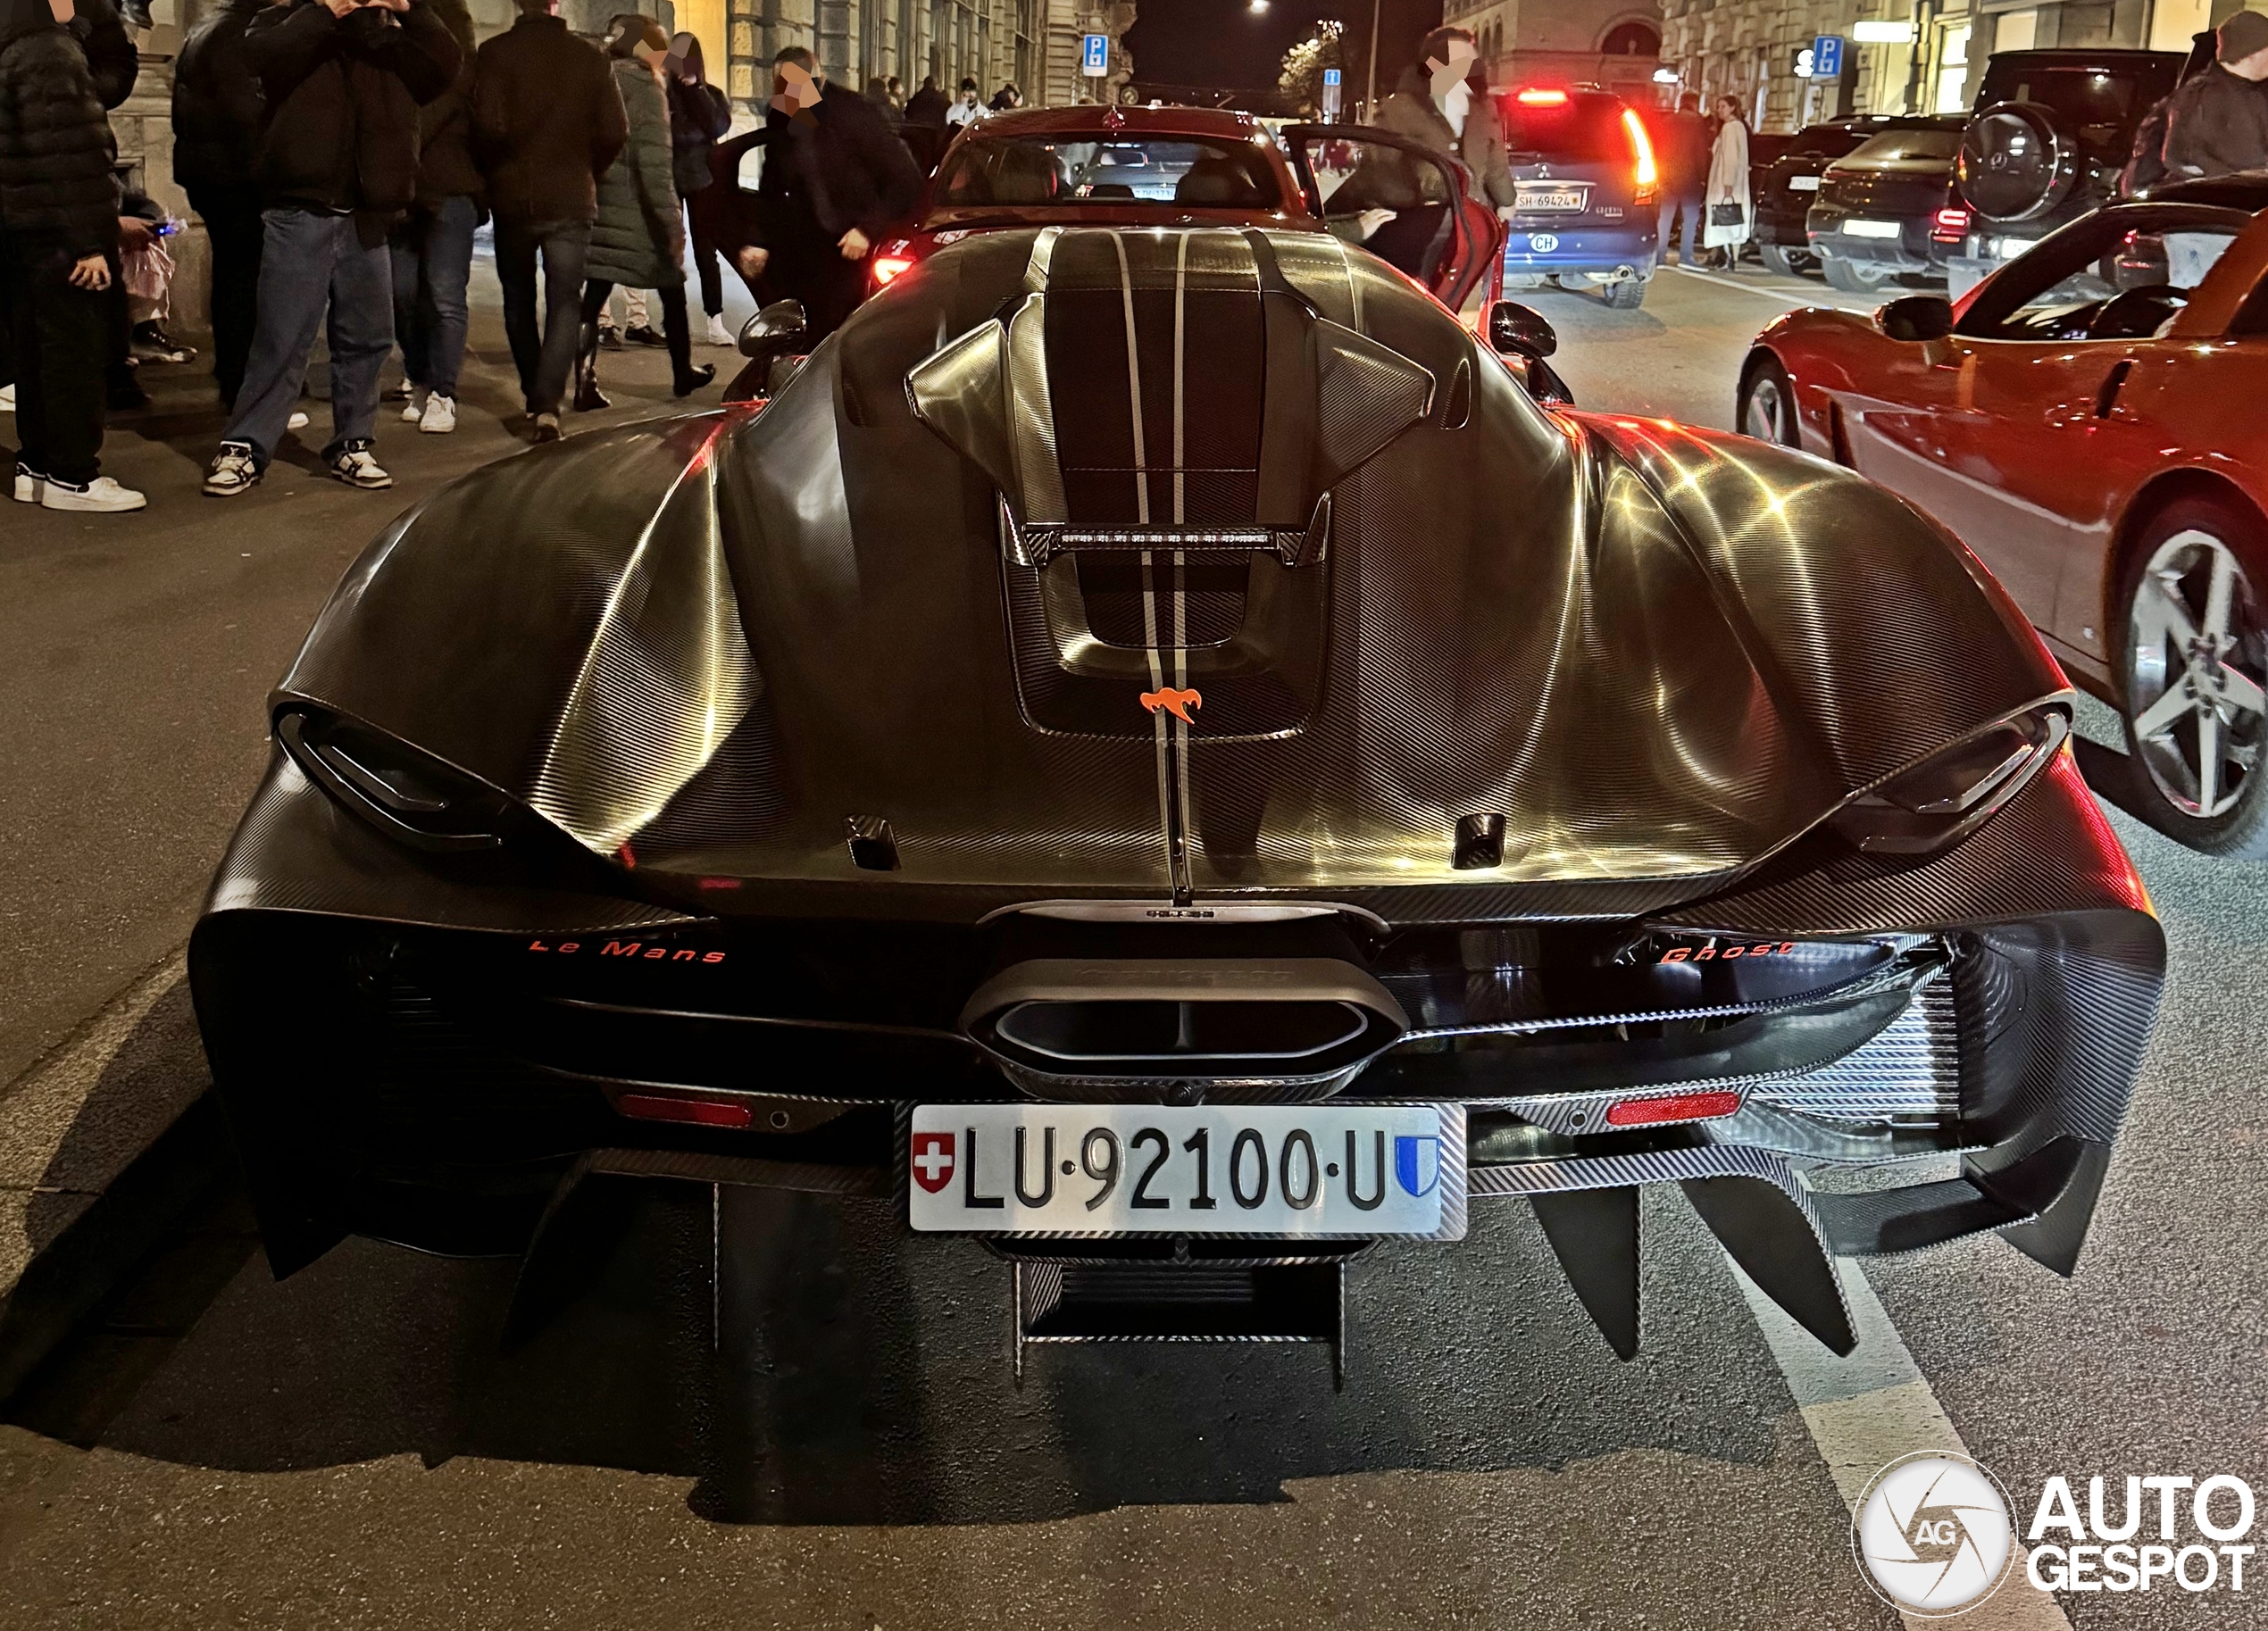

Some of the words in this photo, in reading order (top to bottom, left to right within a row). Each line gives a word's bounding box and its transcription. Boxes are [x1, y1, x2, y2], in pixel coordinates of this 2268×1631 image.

[1090, 37, 1102, 54] P
[1822, 39, 1836, 58] P
[1535, 237, 1553, 249] CH
[529, 940, 580, 953] Le
[600, 941, 726, 963] Mans
[1660, 941, 1796, 964] Ghost
